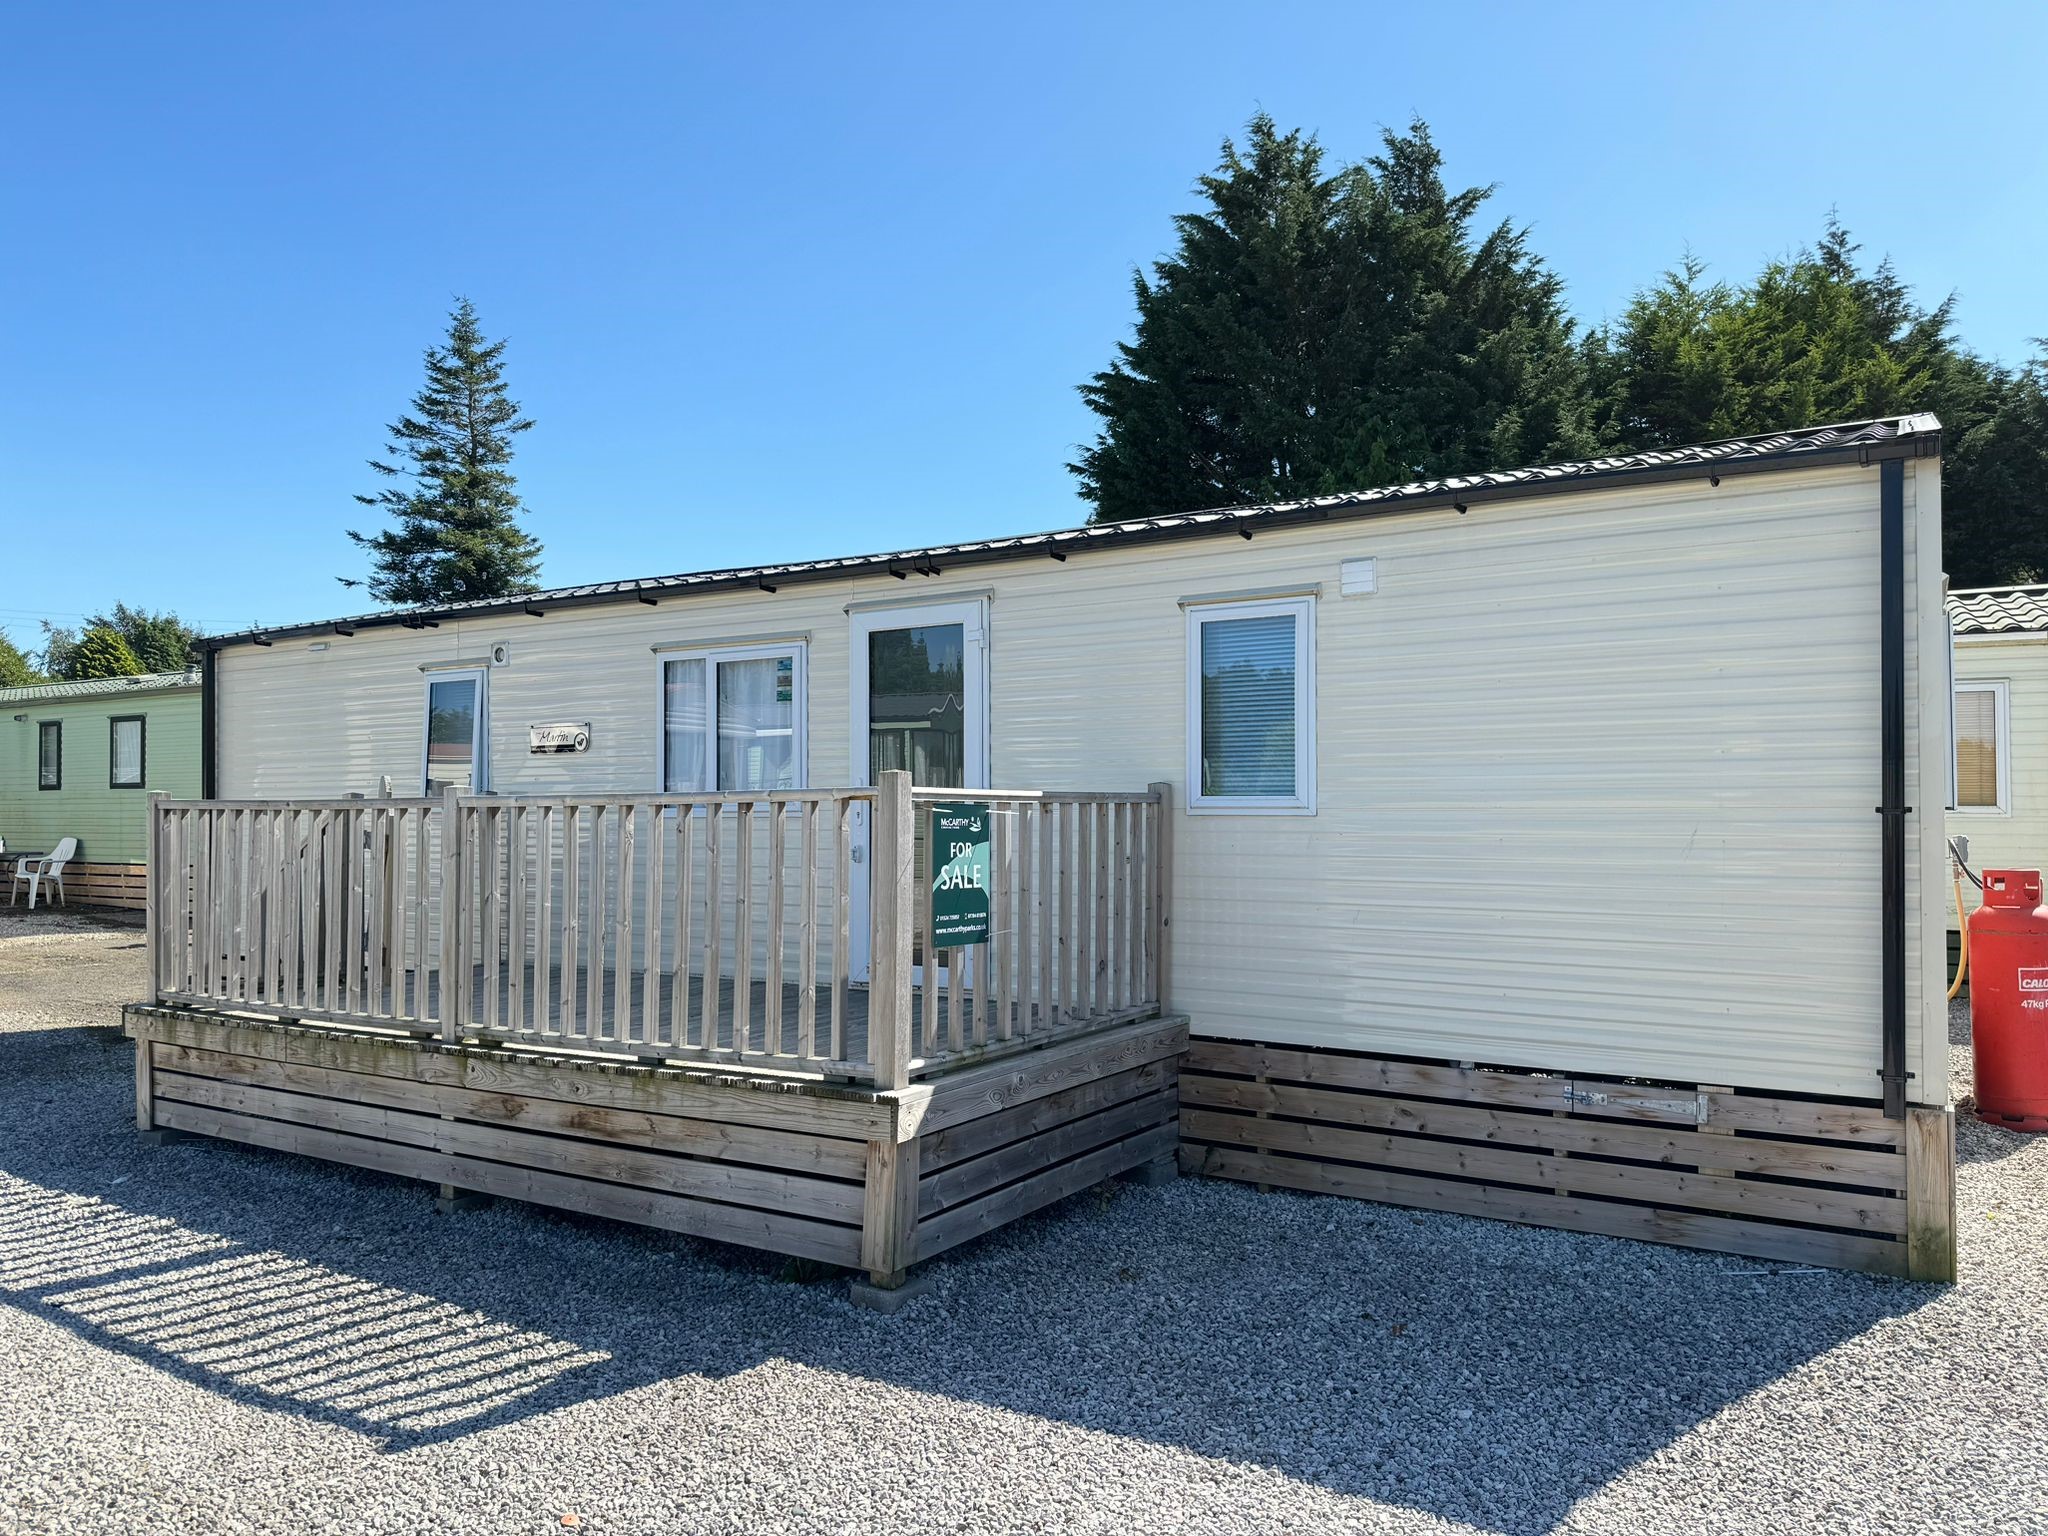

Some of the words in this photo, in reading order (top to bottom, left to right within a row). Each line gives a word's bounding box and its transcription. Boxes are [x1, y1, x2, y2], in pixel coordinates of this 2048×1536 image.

[540, 730, 569, 742] Martin
[941, 818, 969, 826] McCARTHY
[950, 842, 972, 858] FOR
[940, 864, 982, 890] SALE
[2021, 1000, 2044, 1010] 47kg
